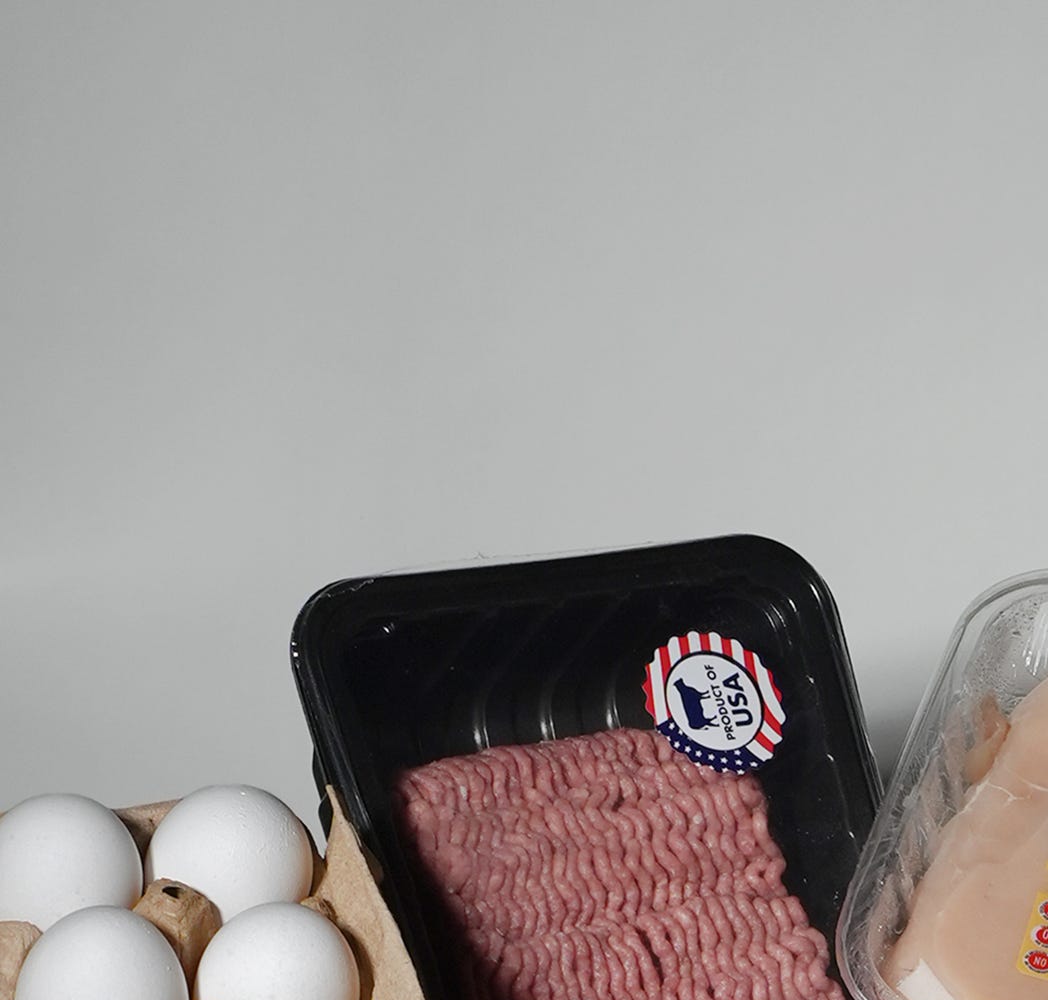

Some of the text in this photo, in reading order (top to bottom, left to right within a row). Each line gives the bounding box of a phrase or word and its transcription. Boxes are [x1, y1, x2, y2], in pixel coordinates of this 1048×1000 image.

[704, 664, 736, 741] PRODUCT OF
[722, 671, 754, 727] USA
